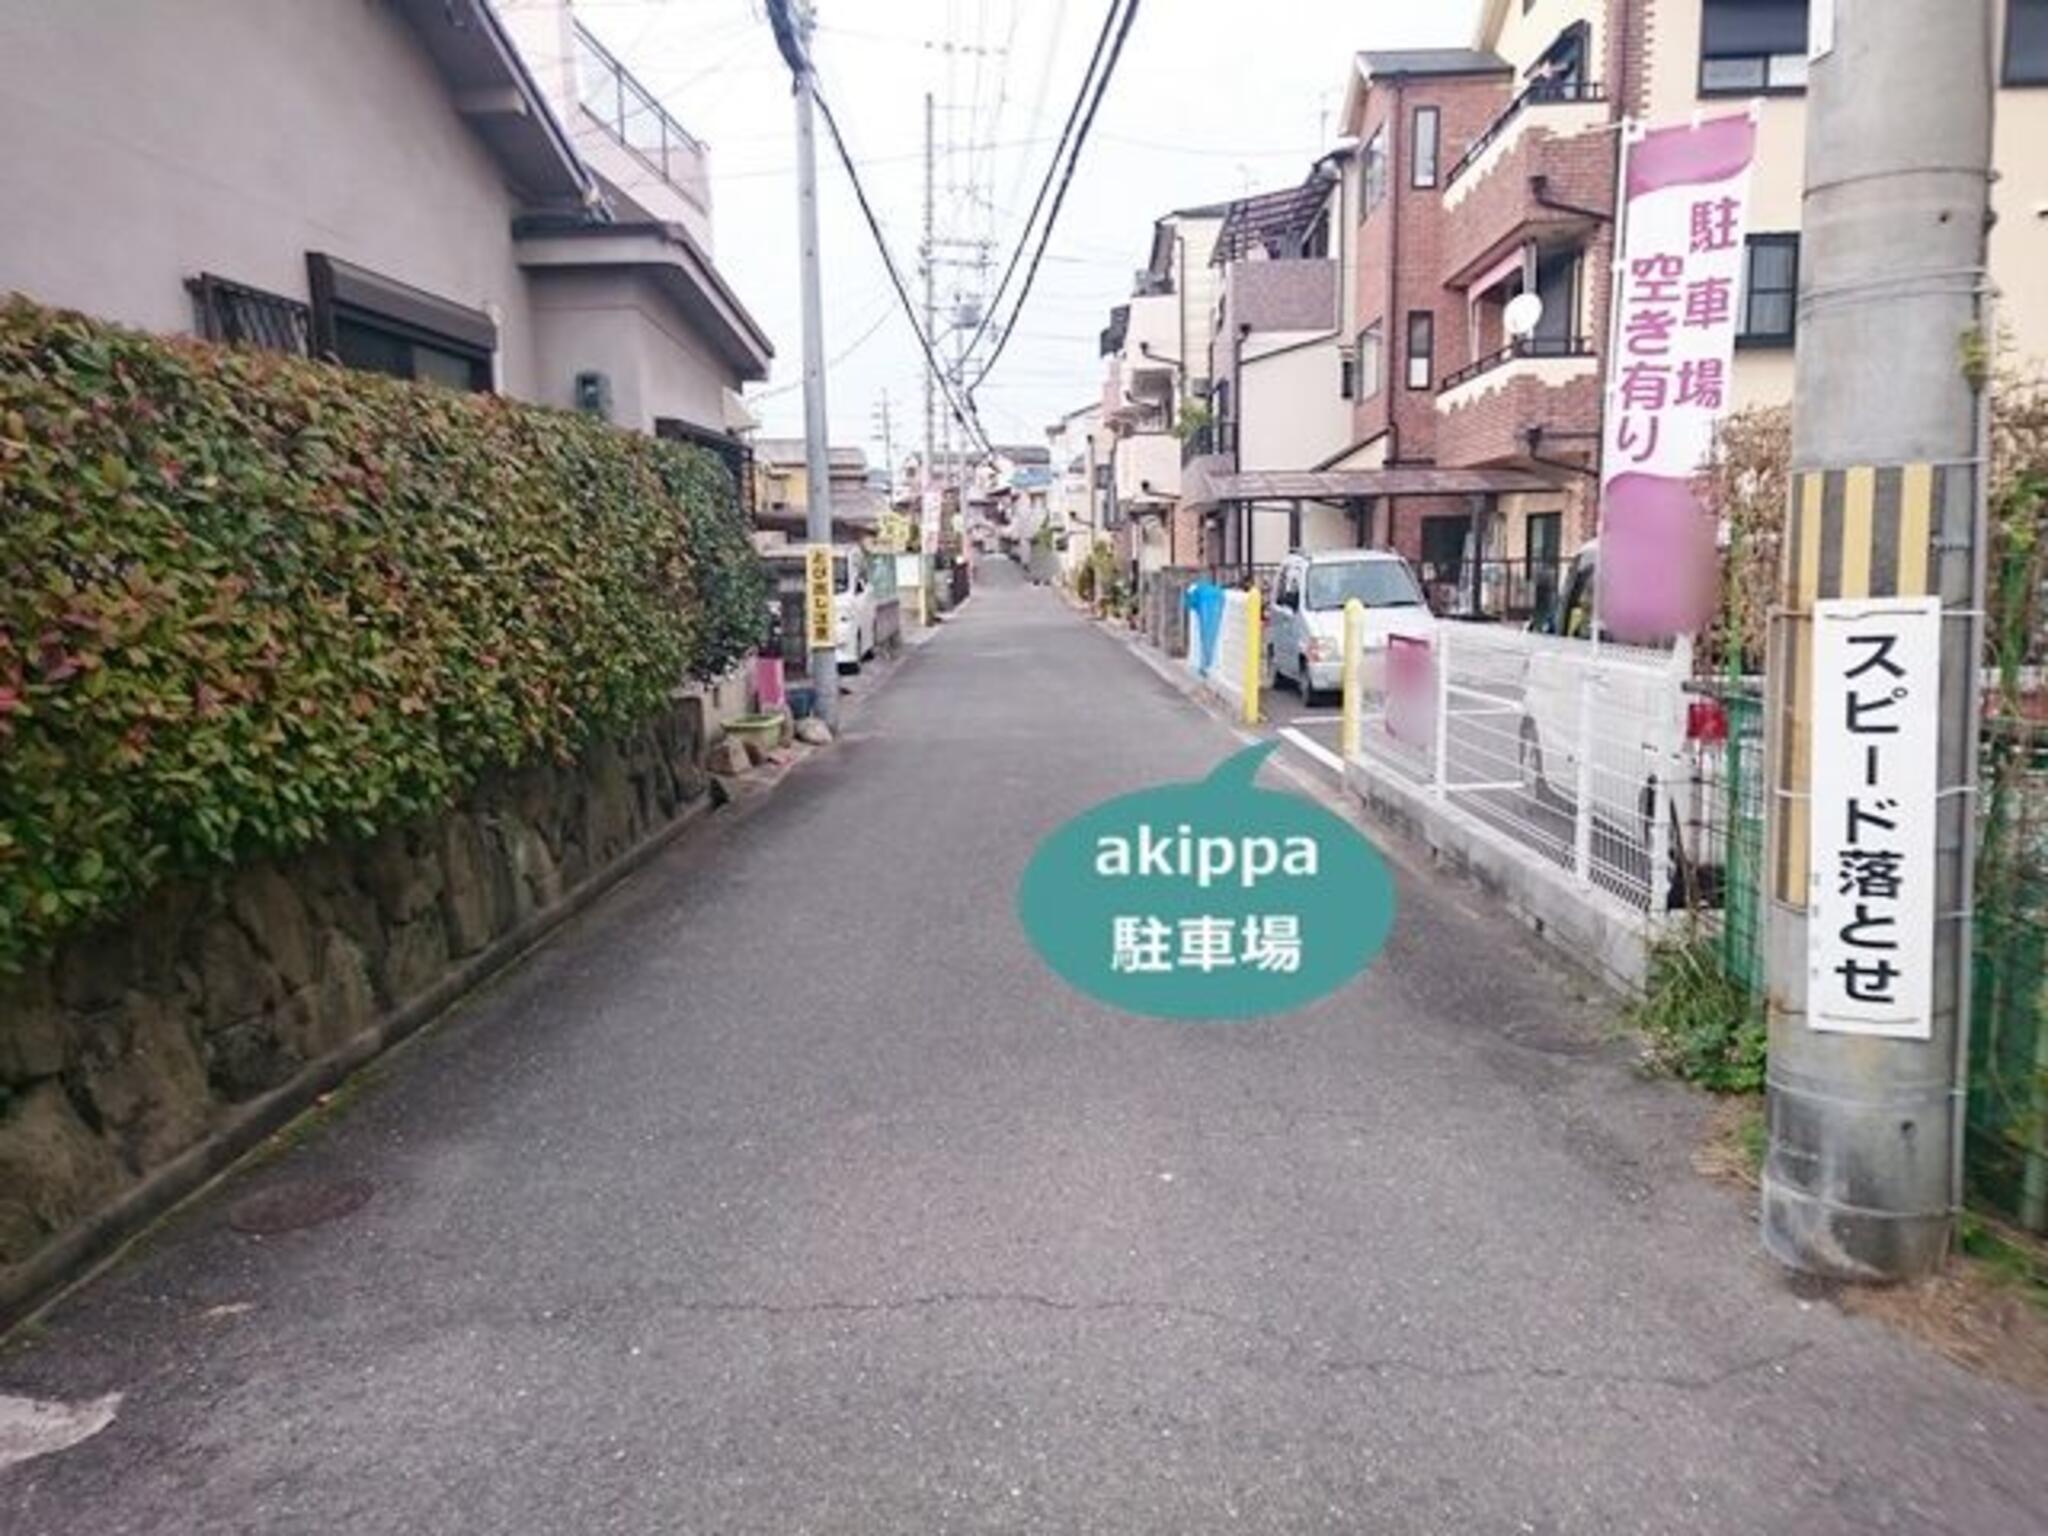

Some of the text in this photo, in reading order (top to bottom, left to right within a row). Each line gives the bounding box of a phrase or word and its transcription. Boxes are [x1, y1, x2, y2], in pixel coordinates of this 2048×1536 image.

[1617, 252, 1684, 462] 空き有り
[1673, 197, 1741, 409] 駐車場
[1835, 634, 1908, 1004] スピード落とせ
